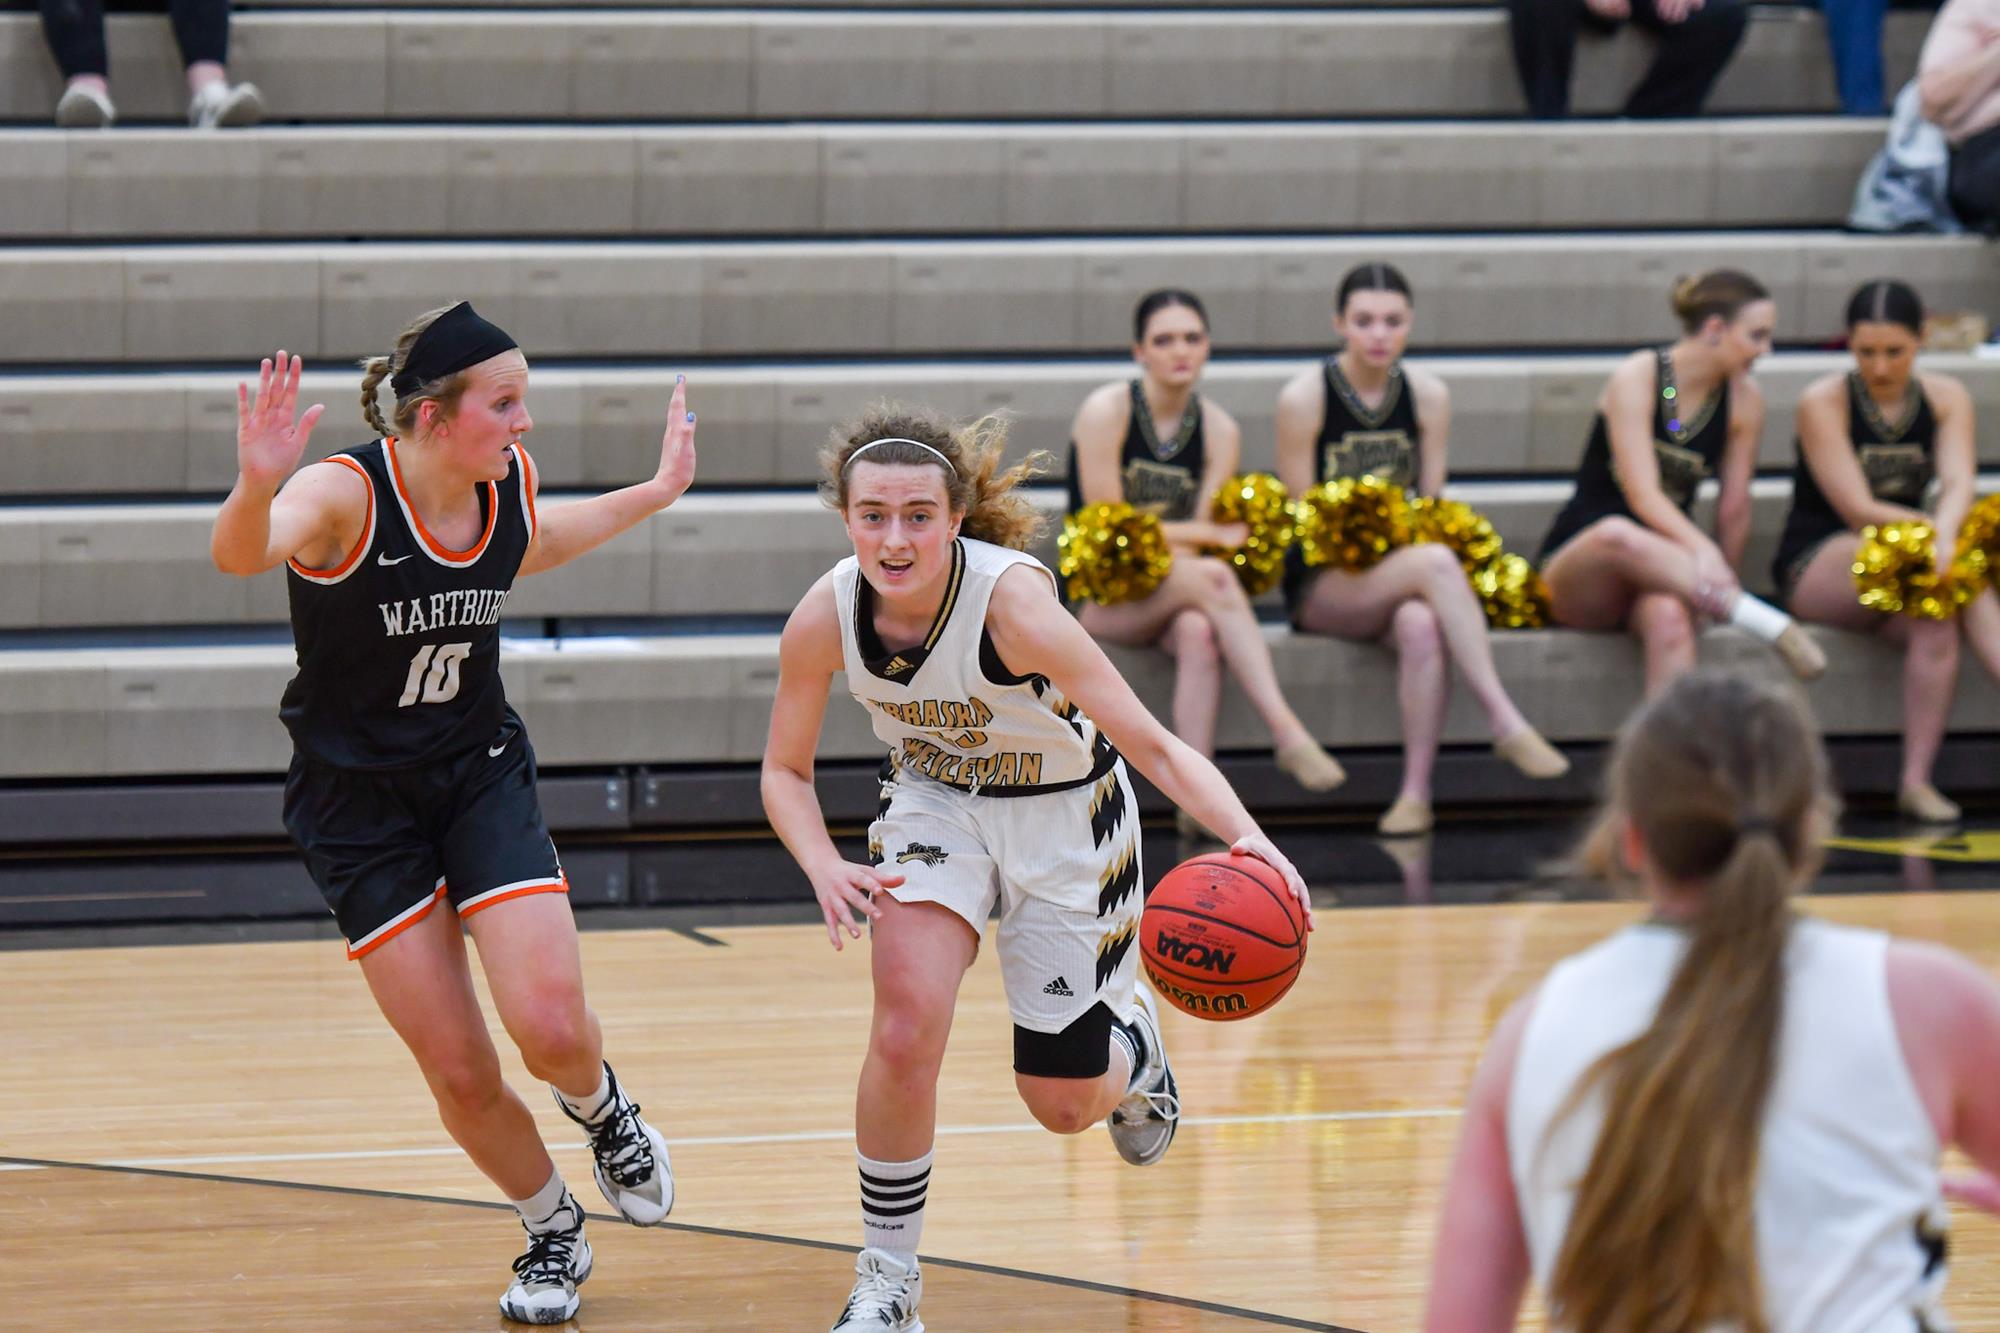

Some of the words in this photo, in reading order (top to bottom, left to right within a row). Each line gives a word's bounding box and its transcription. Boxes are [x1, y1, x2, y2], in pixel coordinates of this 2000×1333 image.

[378, 589, 509, 637] WARTBUR
[398, 642, 472, 708] 10
[867, 697, 994, 729] BRASKA
[1157, 929, 1236, 975] NCAA
[1043, 987, 1074, 997] adidas
